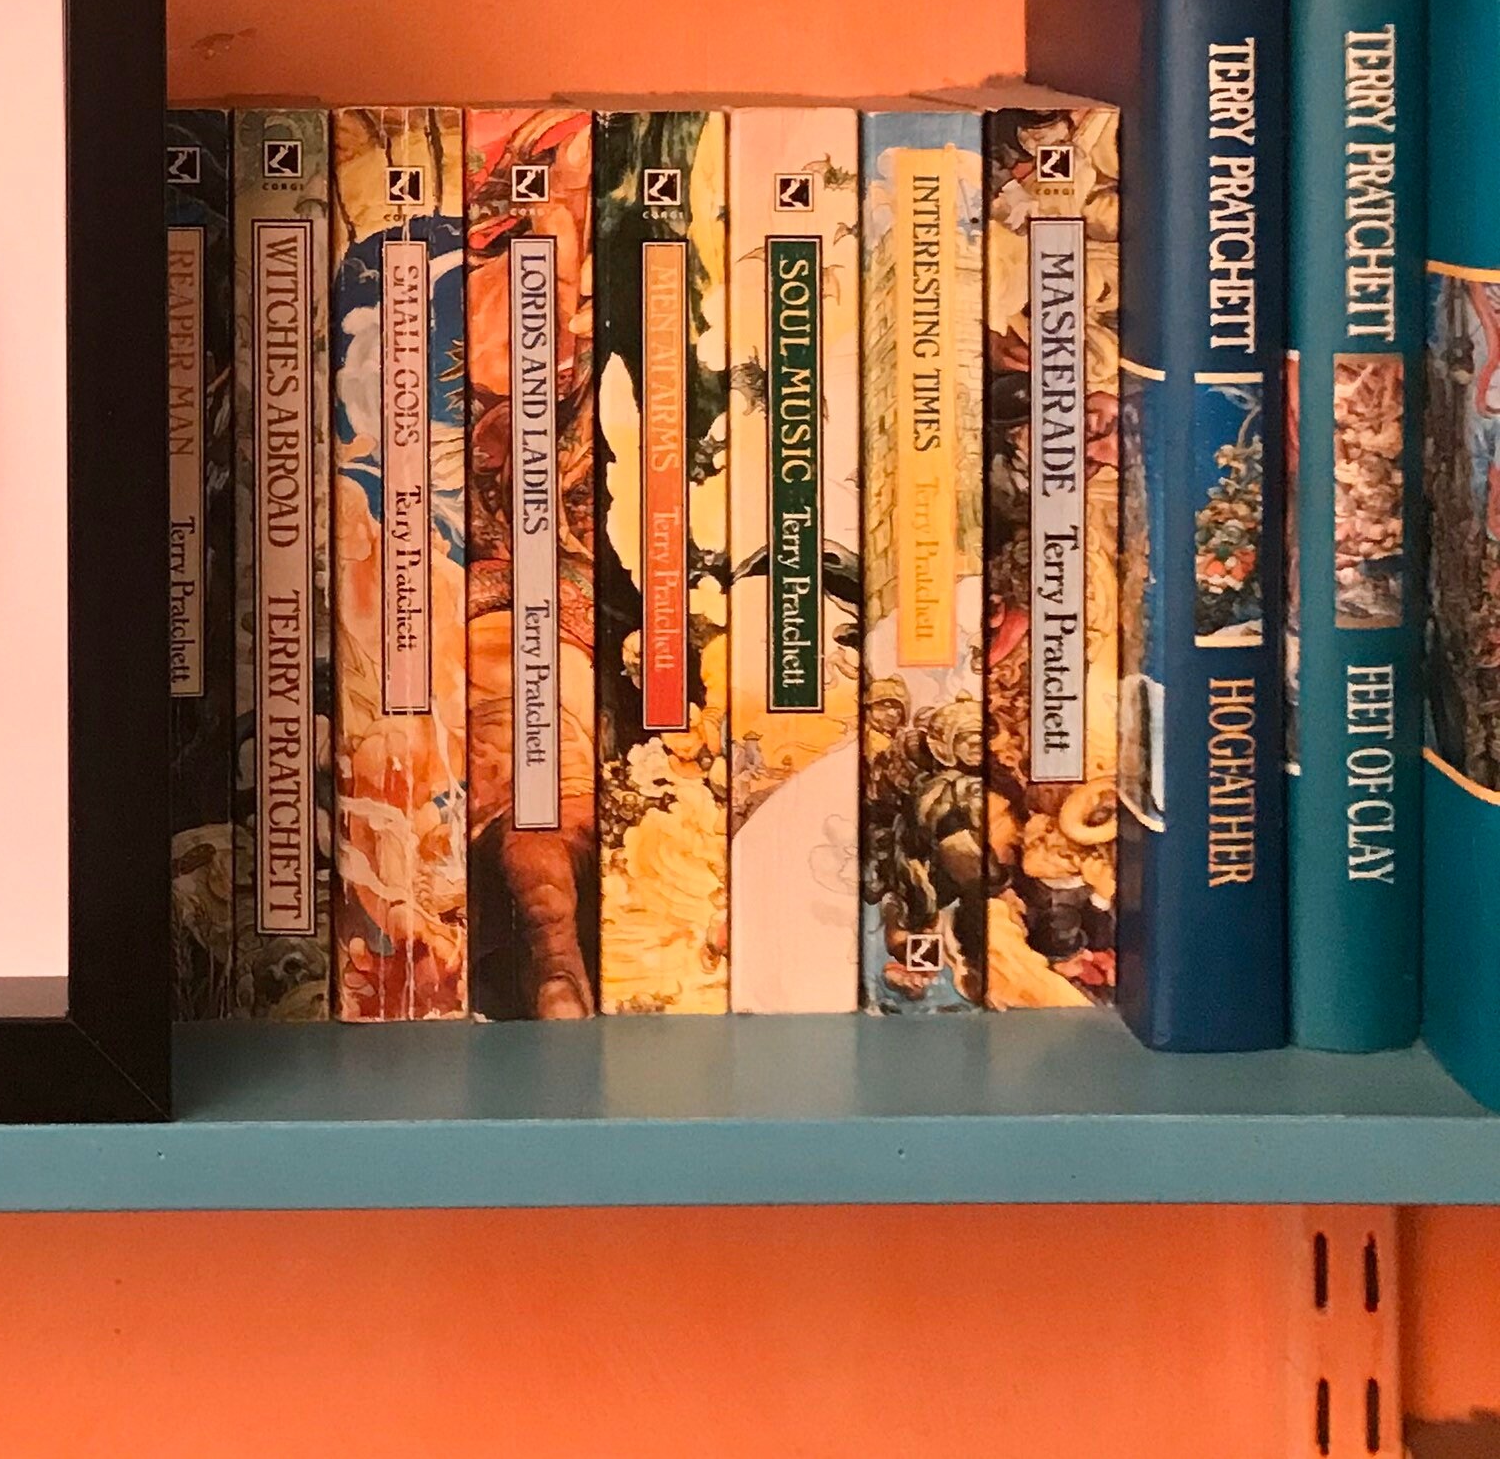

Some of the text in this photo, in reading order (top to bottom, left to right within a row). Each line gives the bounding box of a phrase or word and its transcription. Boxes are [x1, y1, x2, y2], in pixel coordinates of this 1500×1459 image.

[1209, 37, 1257, 354] TERRY PRATCHETT
[1344, 24, 1396, 342] TERRY PRATCHETT
[167, 247, 198, 684] REAPER MAN Terry Pratchett
[263, 236, 302, 920] WITCHES ABROAD TERRY PRATCHETT
[390, 264, 423, 652] SMALL GODS Terry Pratchett
[519, 254, 553, 767] LORDS AND LADIES Terry Pratchett
[647, 508, 682, 673] Terry Pratchett
[776, 258, 814, 689] SOUL MUSIC Terry Pratchett
[912, 174, 941, 640] INTERESTING TIMES Pratchett
[1035, 251, 1080, 755] MASKERADE Terry Pratchett
[1208, 677, 1257, 887] HOGFATHER
[1346, 663, 1395, 884] FEET OF CLAY
